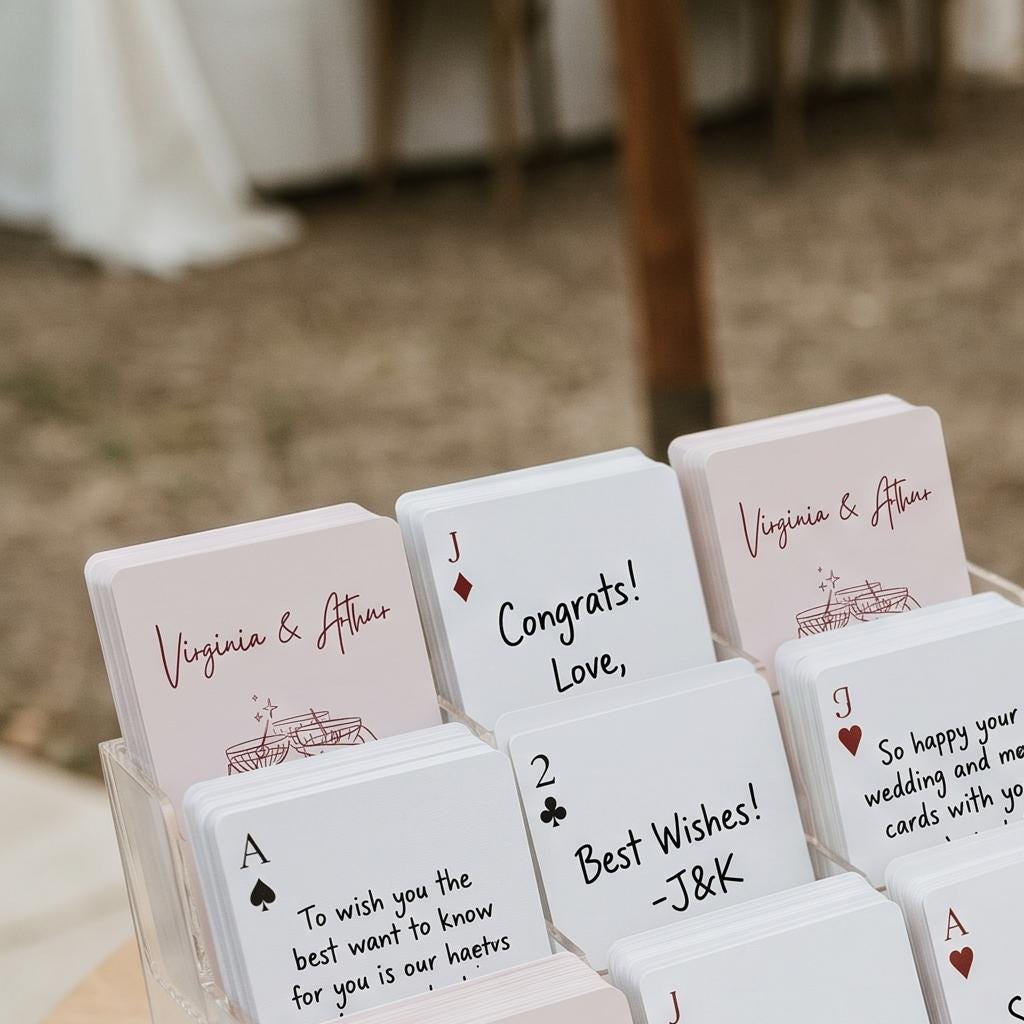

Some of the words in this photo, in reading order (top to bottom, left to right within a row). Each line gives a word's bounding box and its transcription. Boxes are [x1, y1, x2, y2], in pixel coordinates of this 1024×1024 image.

[738, 501, 830, 559] Virginia
[839, 492, 859, 521] &
[870, 475, 933, 531] Arthur
[447, 530, 461, 564] J
[498, 558, 640, 647] Congrats!
[154, 624, 267, 690] Virginia
[278, 610, 302, 644] &
[316, 591, 391, 655] Arthur
[550, 653, 627, 694] Love,
[878, 738, 905, 766] So
[909, 725, 969, 757] happy
[975, 707, 1018, 746] your
[530, 753, 556, 789] 2
[863, 767, 947, 808] wedding
[953, 745, 991, 779] and
[573, 828, 643, 885] Best
[650, 781, 761, 855] Wishes!
[885, 801, 940, 839] cards
[946, 784, 995, 819] with
[239, 832, 271, 870] A
[296, 904, 327, 931] To
[335, 888, 385, 922] wish
[391, 885, 429, 919] you
[434, 867, 473, 897] the
[944, 907, 970, 942] A
[292, 936, 339, 971] best
[347, 922, 402, 956] want
[407, 916, 431, 941] to
[437, 902, 493, 932] know
[291, 984, 323, 1011] for
[332, 975, 371, 1010] you
[376, 964, 396, 986] is
[403, 954, 437, 977] our
